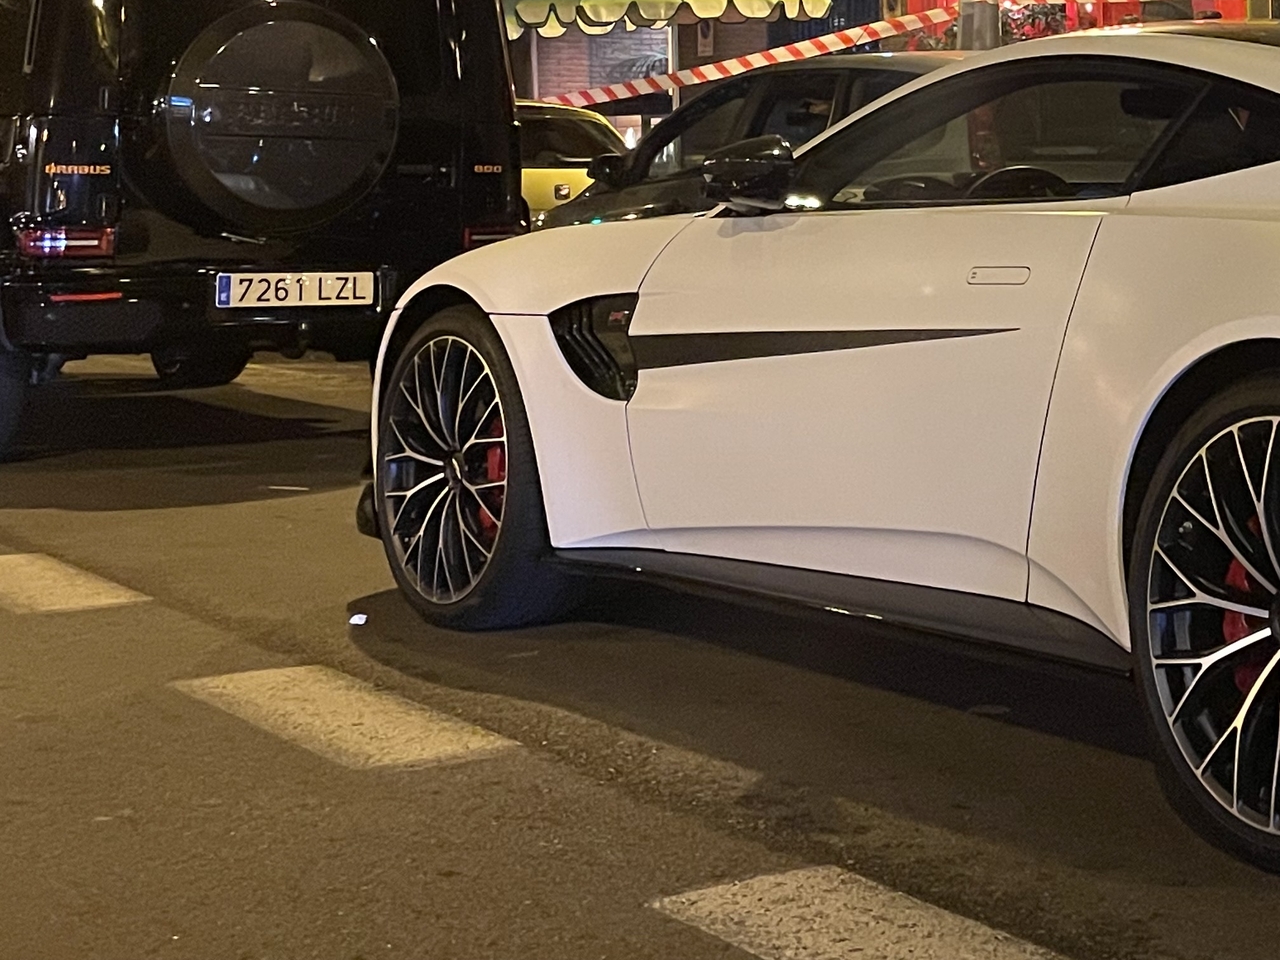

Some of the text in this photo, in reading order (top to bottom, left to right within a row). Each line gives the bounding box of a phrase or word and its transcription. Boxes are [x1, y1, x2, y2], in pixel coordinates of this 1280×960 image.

[45, 164, 111, 175] BRABUS
[238, 278, 303, 302] 7261
[318, 276, 366, 301] LZL
